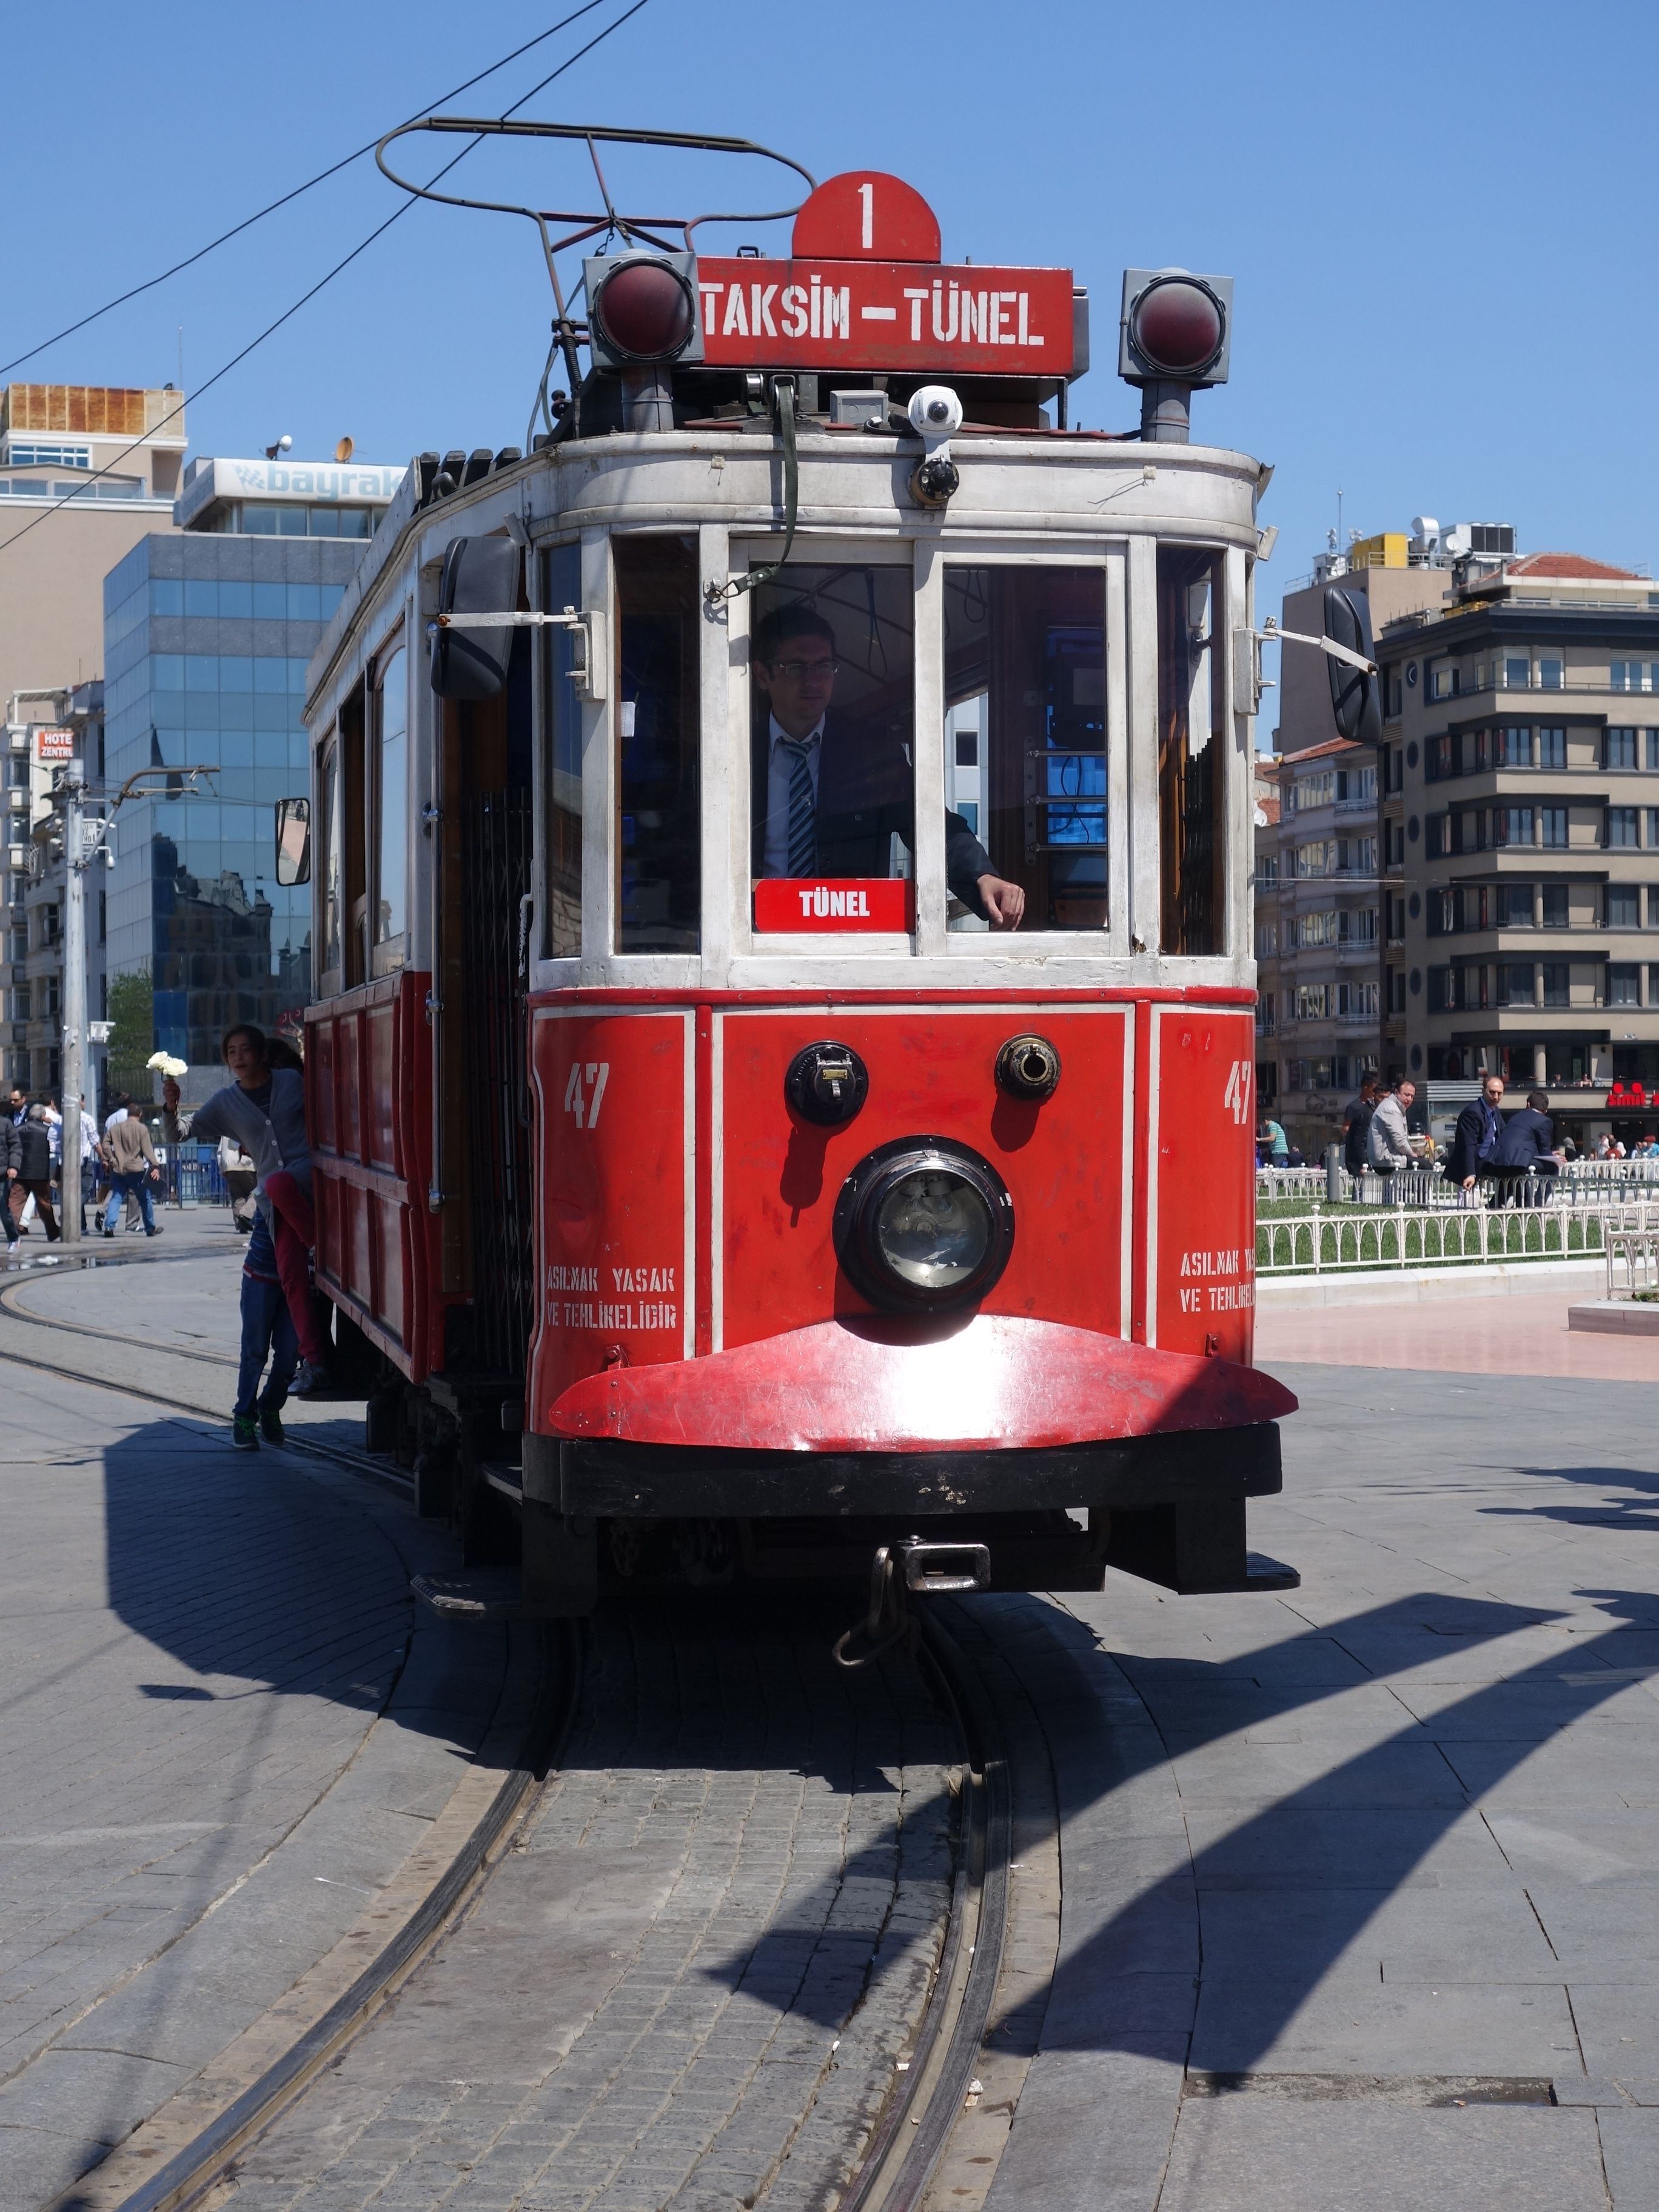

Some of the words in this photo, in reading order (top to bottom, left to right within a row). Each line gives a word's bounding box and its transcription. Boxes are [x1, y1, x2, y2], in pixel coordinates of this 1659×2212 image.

[857, 183, 873, 249] 1
[699, 274, 850, 340] TAKSİM
[903, 280, 1045, 346] TÜNEL
[799, 886, 870, 917] TÜNEL
[565, 1062, 609, 1128] 47
[1224, 1061, 1252, 1125] 47
[547, 1265, 598, 1292] ASILMAK
[612, 1268, 675, 1292] YASAK
[1180, 1249, 1239, 1277] ASILMAK
[547, 1301, 559, 1327] VE
[1179, 1288, 1201, 1313] VE
